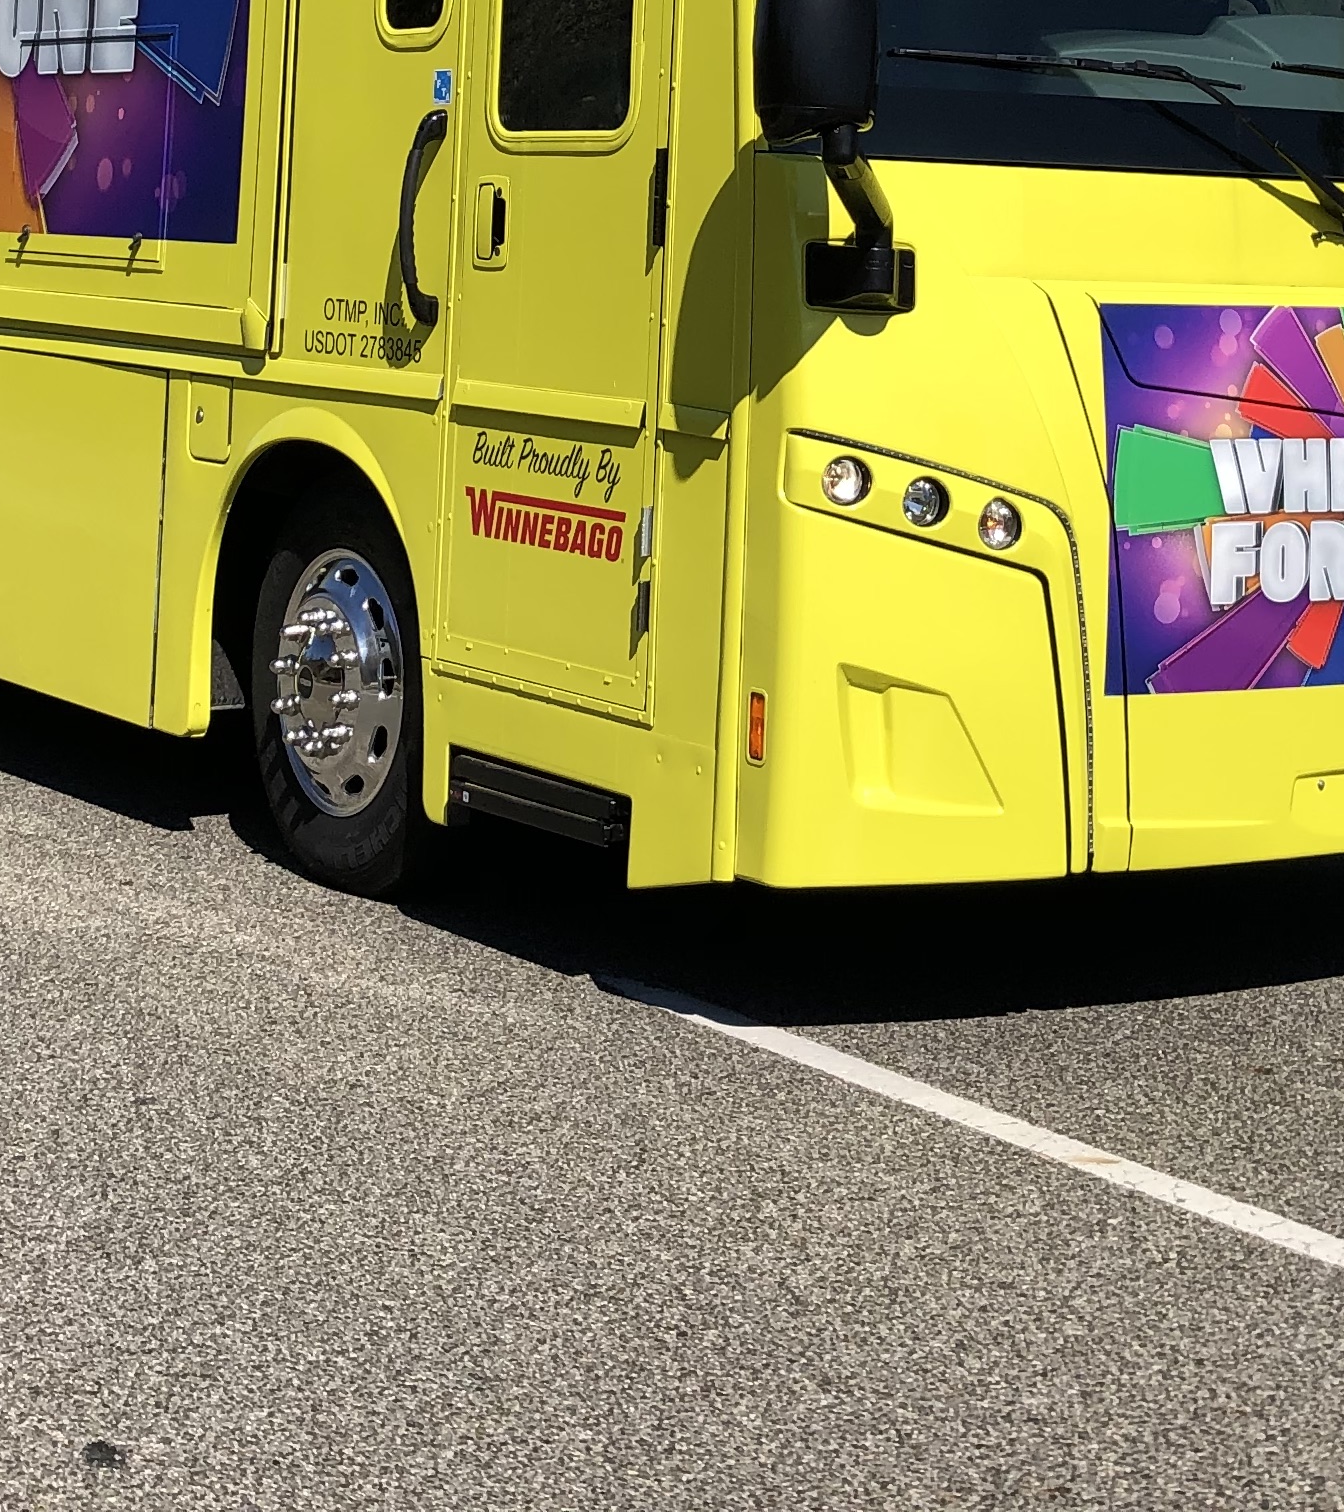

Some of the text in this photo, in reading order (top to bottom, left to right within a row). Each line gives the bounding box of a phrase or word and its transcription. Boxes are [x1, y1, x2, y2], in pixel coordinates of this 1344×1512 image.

[324, 297, 369, 328] OTMP,
[304, 329, 422, 364] USDOT 2783845
[472, 430, 622, 504] Built Proudly By
[465, 485, 627, 564] WINNEBAGO
